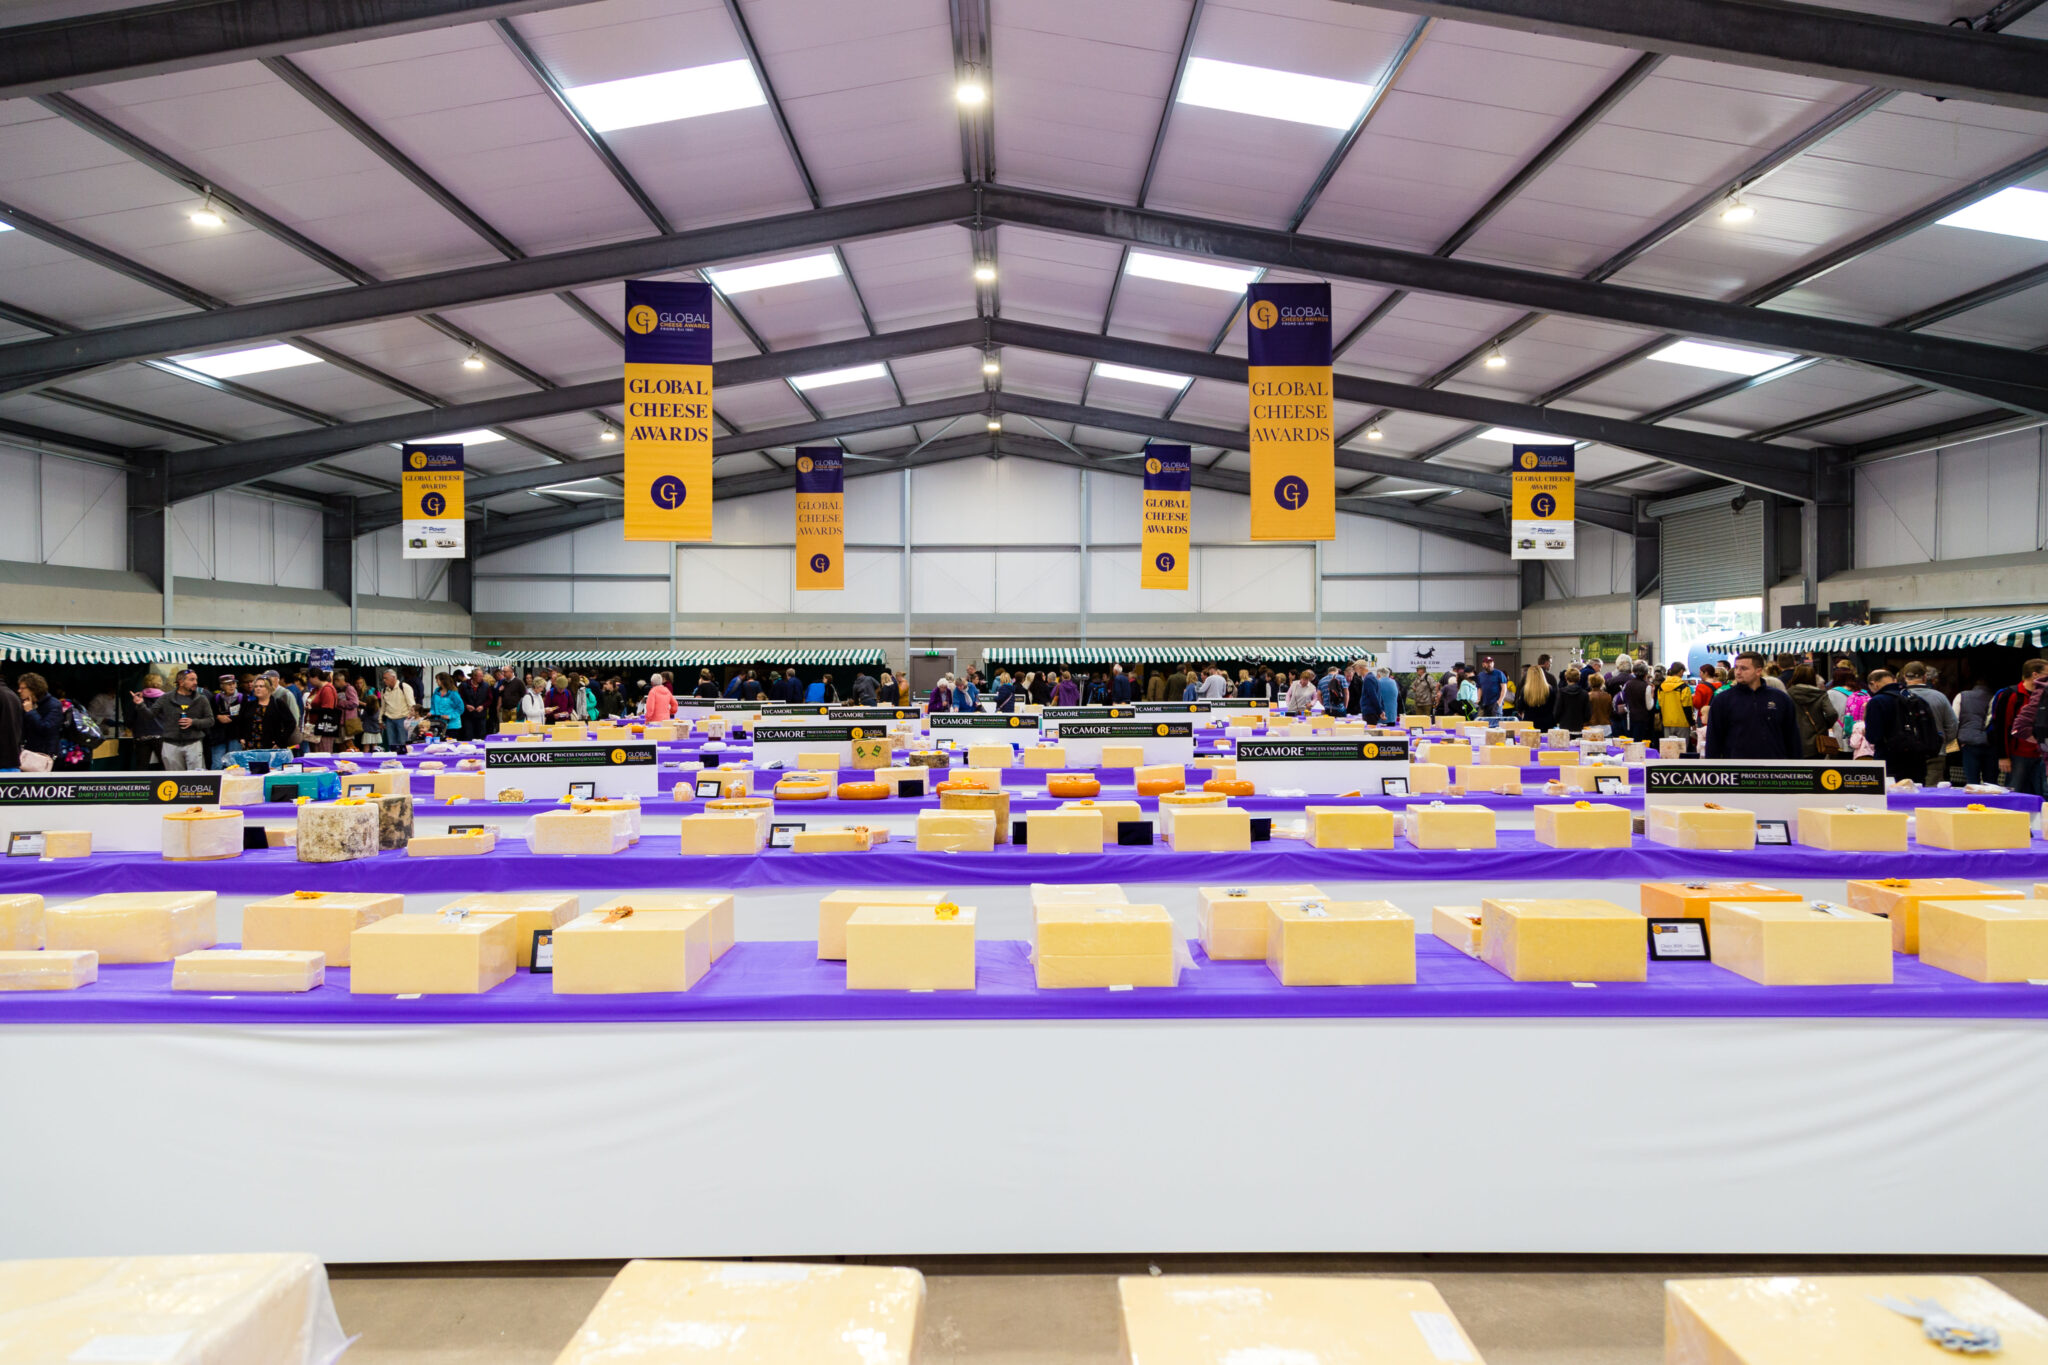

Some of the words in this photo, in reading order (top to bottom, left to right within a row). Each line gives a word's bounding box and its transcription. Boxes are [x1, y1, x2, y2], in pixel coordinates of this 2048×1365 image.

[1281, 306, 1328, 317] GLOBAL
[660, 312, 710, 324] GLOBAL
[629, 378, 708, 396] GLOBAL
[1252, 382, 1328, 396] GLOBAL
[630, 402, 708, 419] CHEESE
[1254, 404, 1328, 419] CHEESE
[630, 426, 708, 442] AWARDS
[1252, 427, 1330, 442] AWARDS
[798, 502, 842, 510] GLOBAL
[1146, 498, 1188, 508] GLOBAL
[798, 514, 840, 522] CHEESE
[1146, 512, 1188, 522] CHEESE
[798, 526, 842, 536] AWARDS
[1146, 525, 1188, 534] AWARDS
[756, 730, 806, 738] SYCAMORE
[1062, 726, 1112, 734] SYCAMORE
[1240, 746, 1304, 756] SYCAMORE
[490, 753, 553, 763] SYCAMORE
[1651, 772, 1740, 786] SYCAMORE
[0, 786, 76, 798] YCAMORE
[180, 784, 214, 792] GLOBAL
